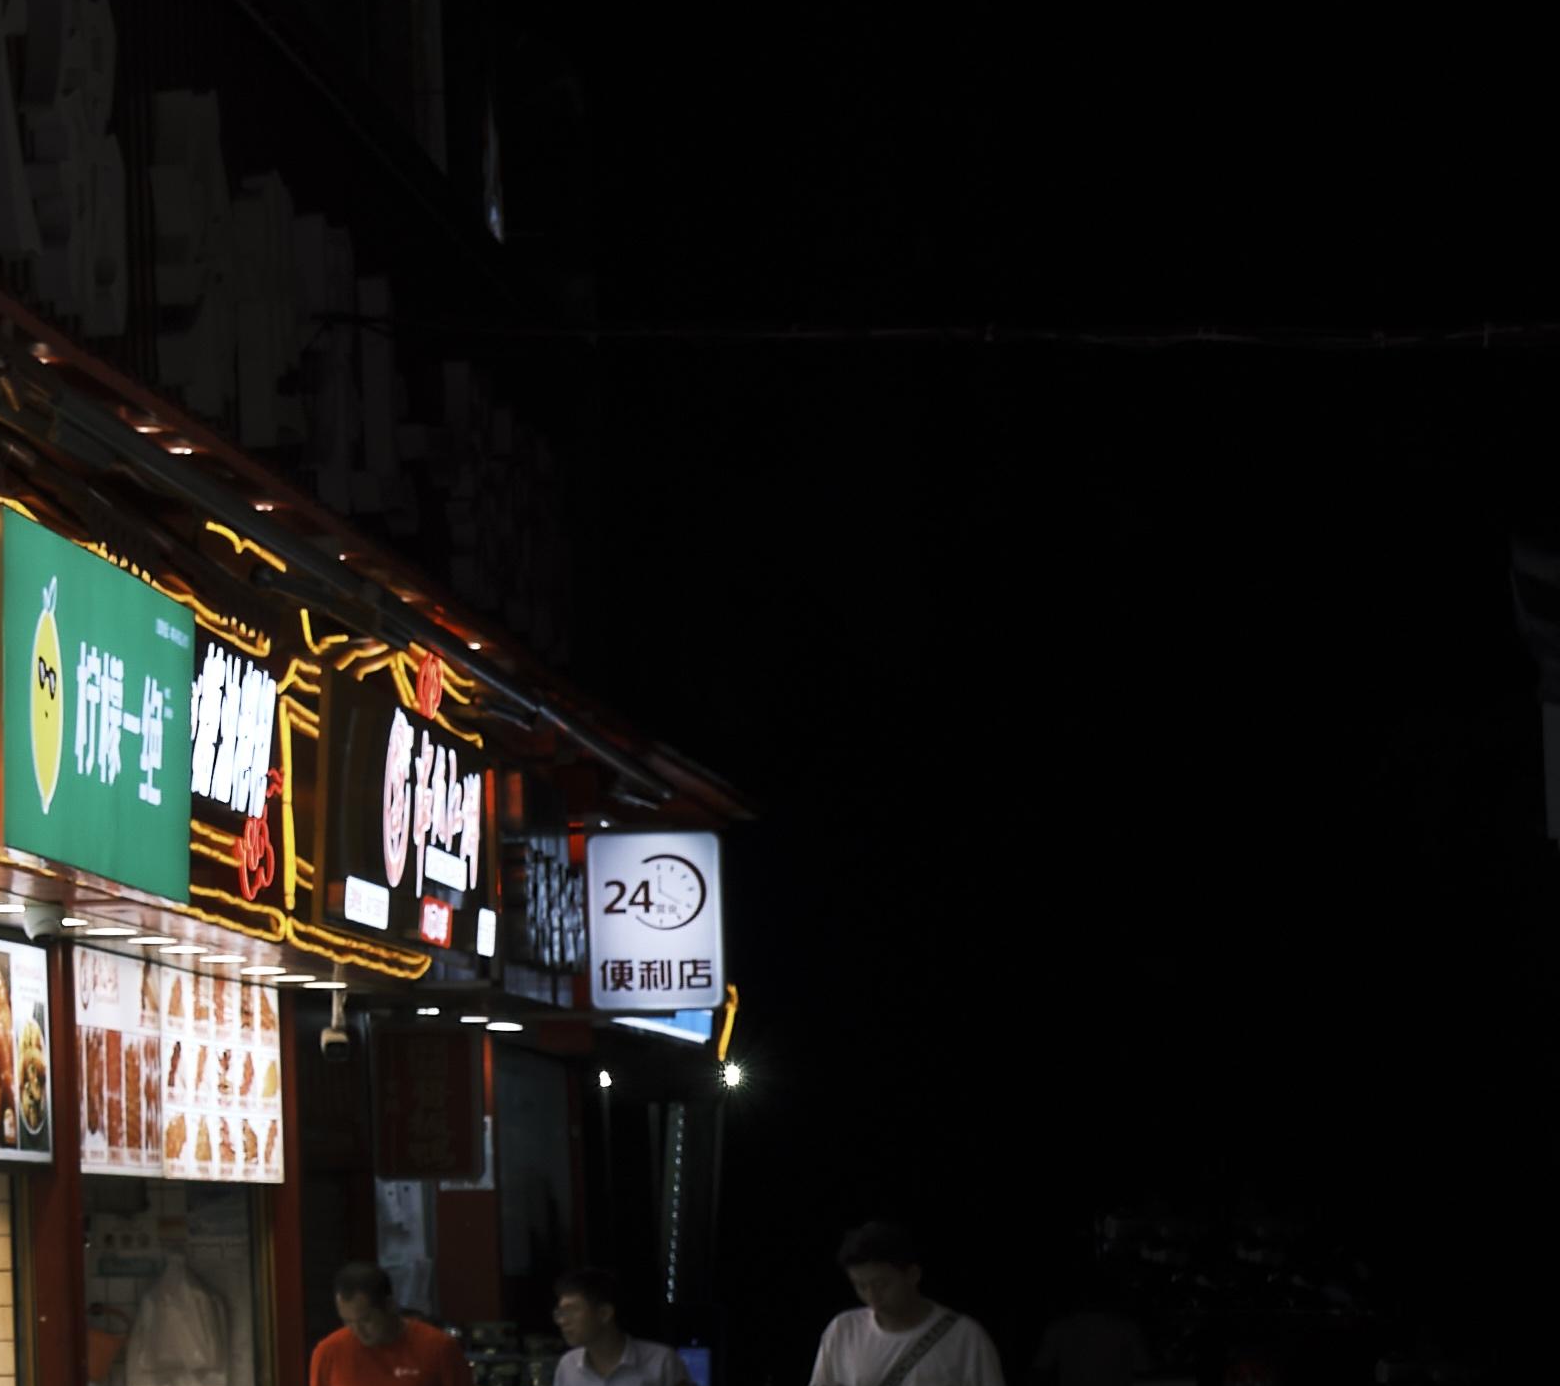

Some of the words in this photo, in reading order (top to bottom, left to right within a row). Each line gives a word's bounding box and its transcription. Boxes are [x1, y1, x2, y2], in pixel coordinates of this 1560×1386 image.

[603, 879, 655, 915] 24
[600, 958, 713, 992] 便利店
